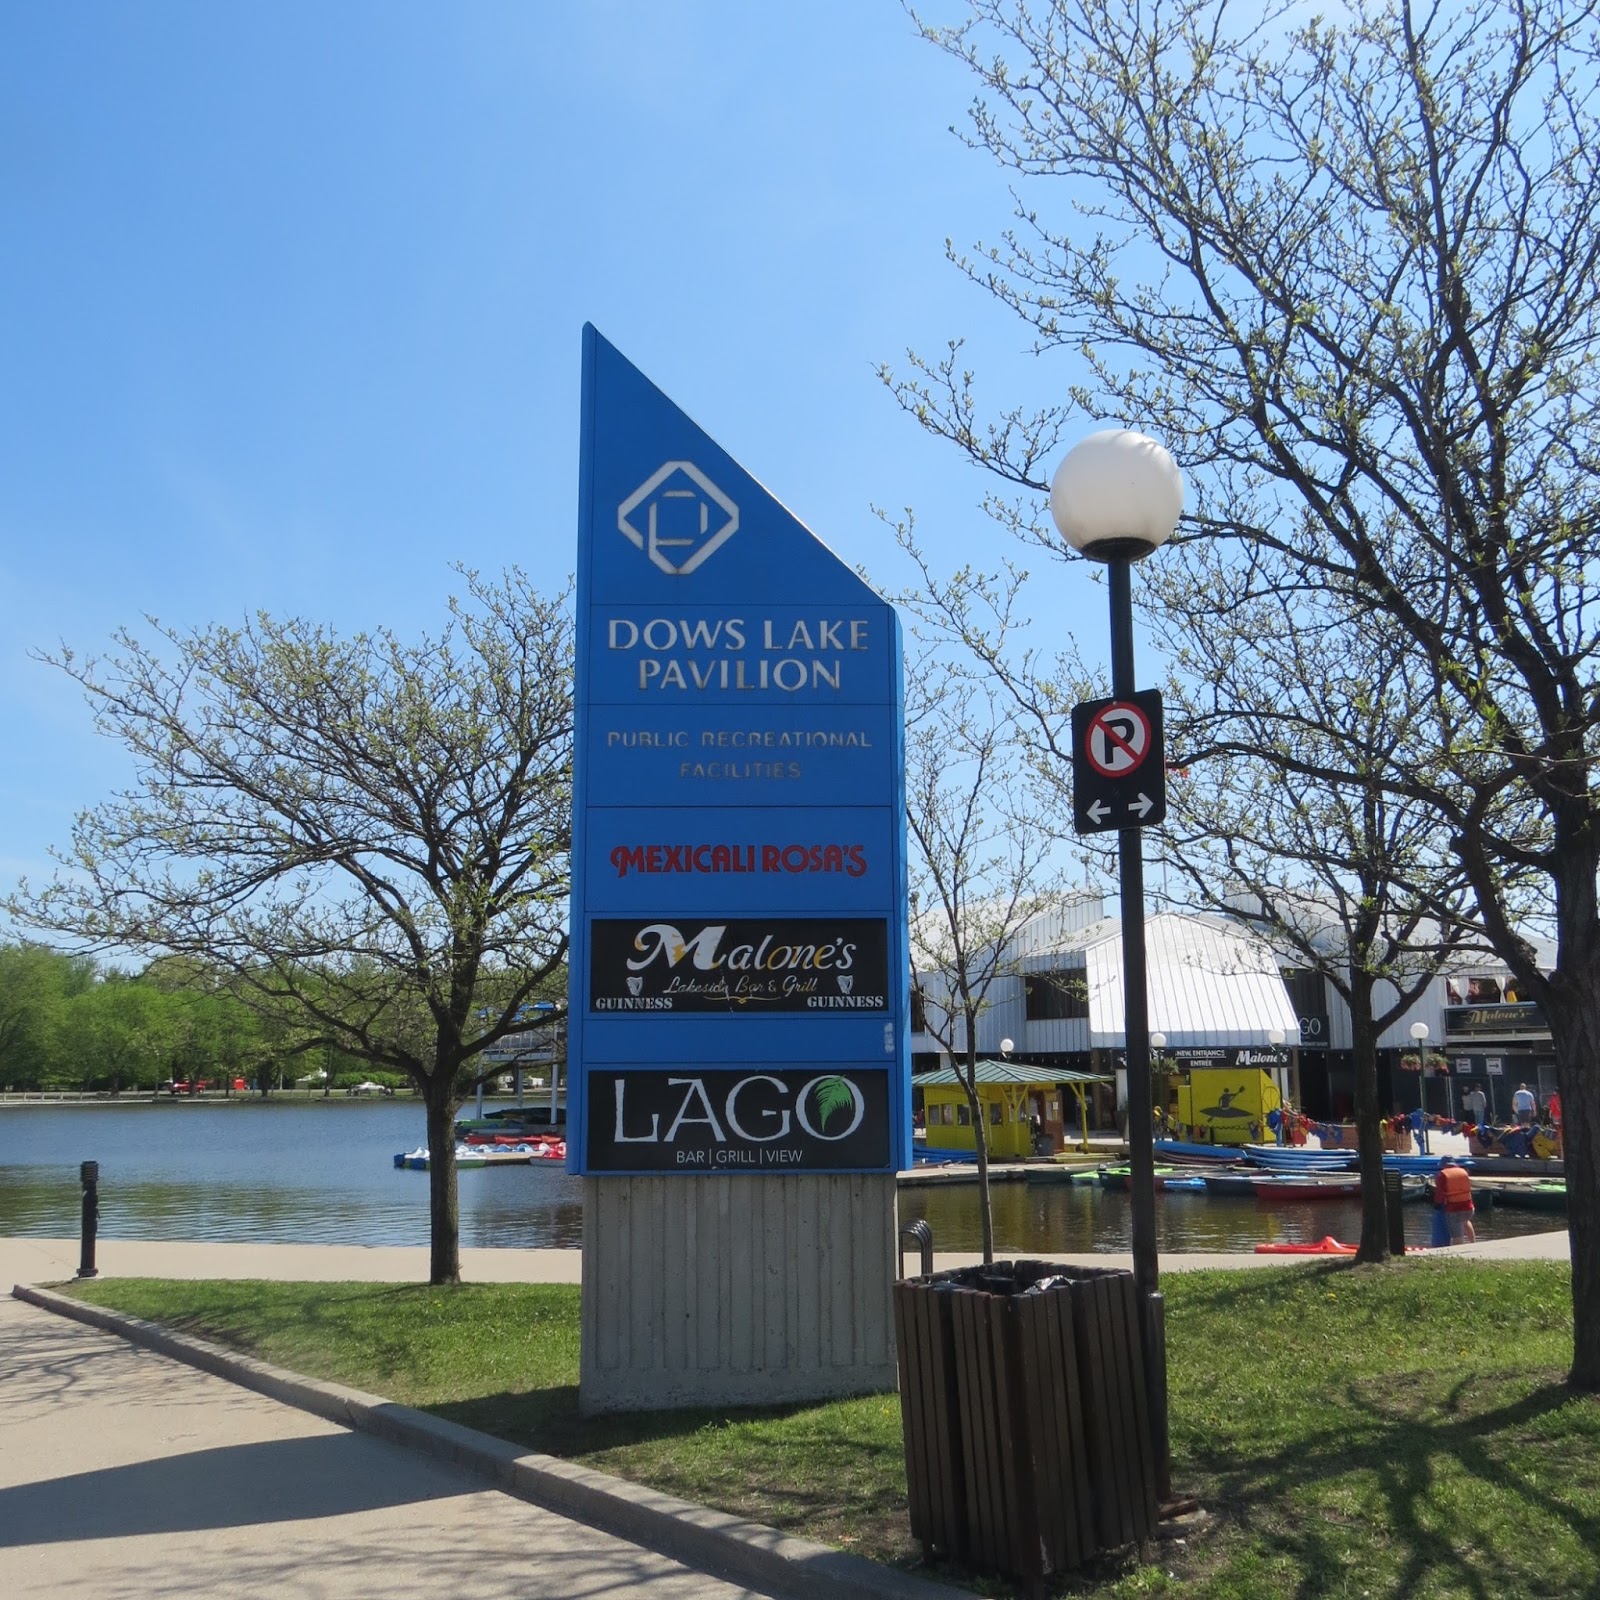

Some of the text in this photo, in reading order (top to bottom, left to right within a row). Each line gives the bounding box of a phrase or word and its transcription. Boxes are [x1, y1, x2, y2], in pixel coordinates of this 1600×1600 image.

[608, 619, 869, 650] DOWS LAKE
[638, 659, 841, 692] PAVILION
[608, 731, 873, 748] PUBLIC RECREATIONAL
[679, 761, 802, 779] FACILITIES
[610, 844, 867, 878] MEXICALI ROSA'S
[626, 923, 857, 971] Malone's
[735, 975, 764, 994] Bar
[767, 980, 777, 993] &
[782, 975, 818, 998] Grill
[595, 997, 673, 1010] GUINNESS
[807, 995, 884, 1008] GUINNESS
[1465, 1009, 1526, 1024] Malone's
[614, 1074, 865, 1143] LAGO
[676, 1150, 803, 1164] BAR GRILL VIEW
